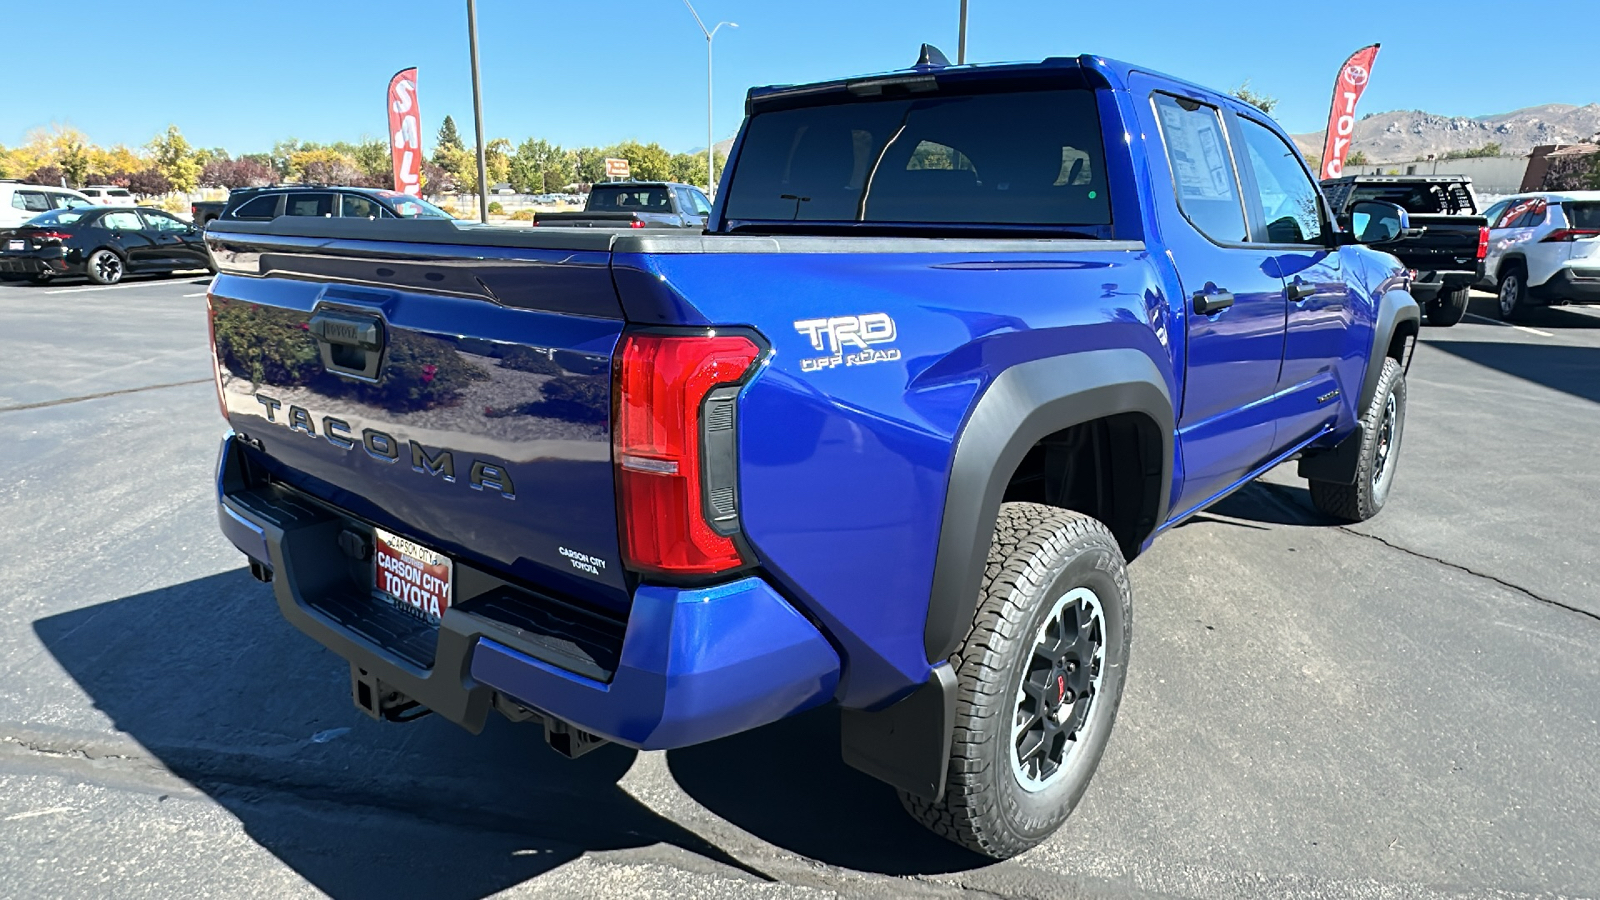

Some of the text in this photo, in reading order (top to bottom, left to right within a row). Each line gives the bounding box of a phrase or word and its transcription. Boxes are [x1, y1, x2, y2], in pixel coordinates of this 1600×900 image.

[794, 312, 897, 355] TRD
[801, 348, 902, 372] OFF ROAD
[255, 393, 516, 500] TACOMA
[390, 536, 434, 564] CARSON CITY
[558, 546, 606, 569] CARSON CITY
[377, 551, 449, 598] CARSON CITY
[570, 559, 600, 576] TOYOTA
[384, 571, 442, 619] TOYOTA
[393, 599, 430, 624] TOYOTA
